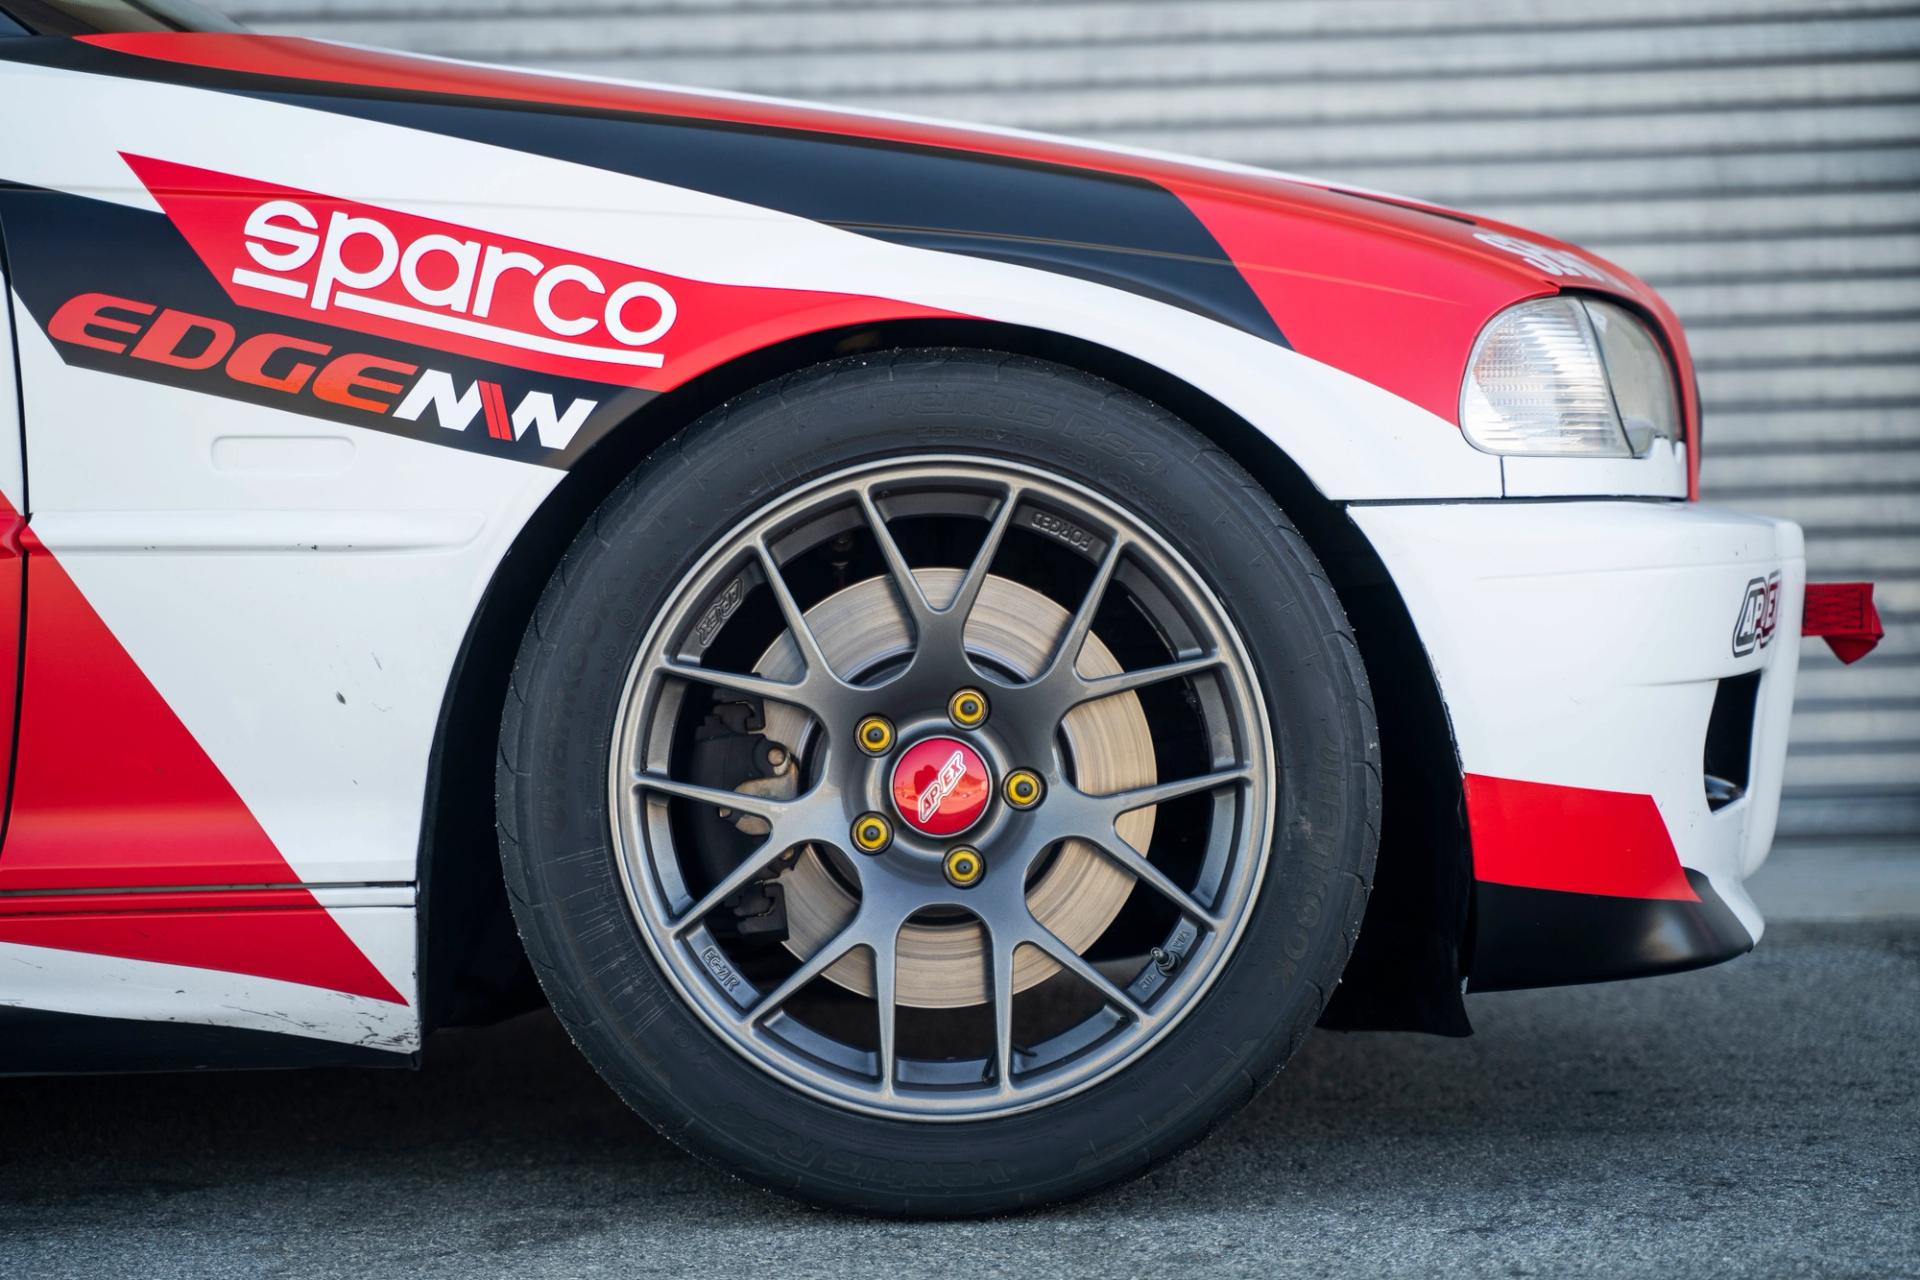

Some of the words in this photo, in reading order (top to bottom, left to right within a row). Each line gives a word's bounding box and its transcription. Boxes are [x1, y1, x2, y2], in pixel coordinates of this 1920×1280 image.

[243, 201, 678, 347] sparco
[1031, 512, 1093, 552] FORGED
[920, 754, 964, 819] APEX
